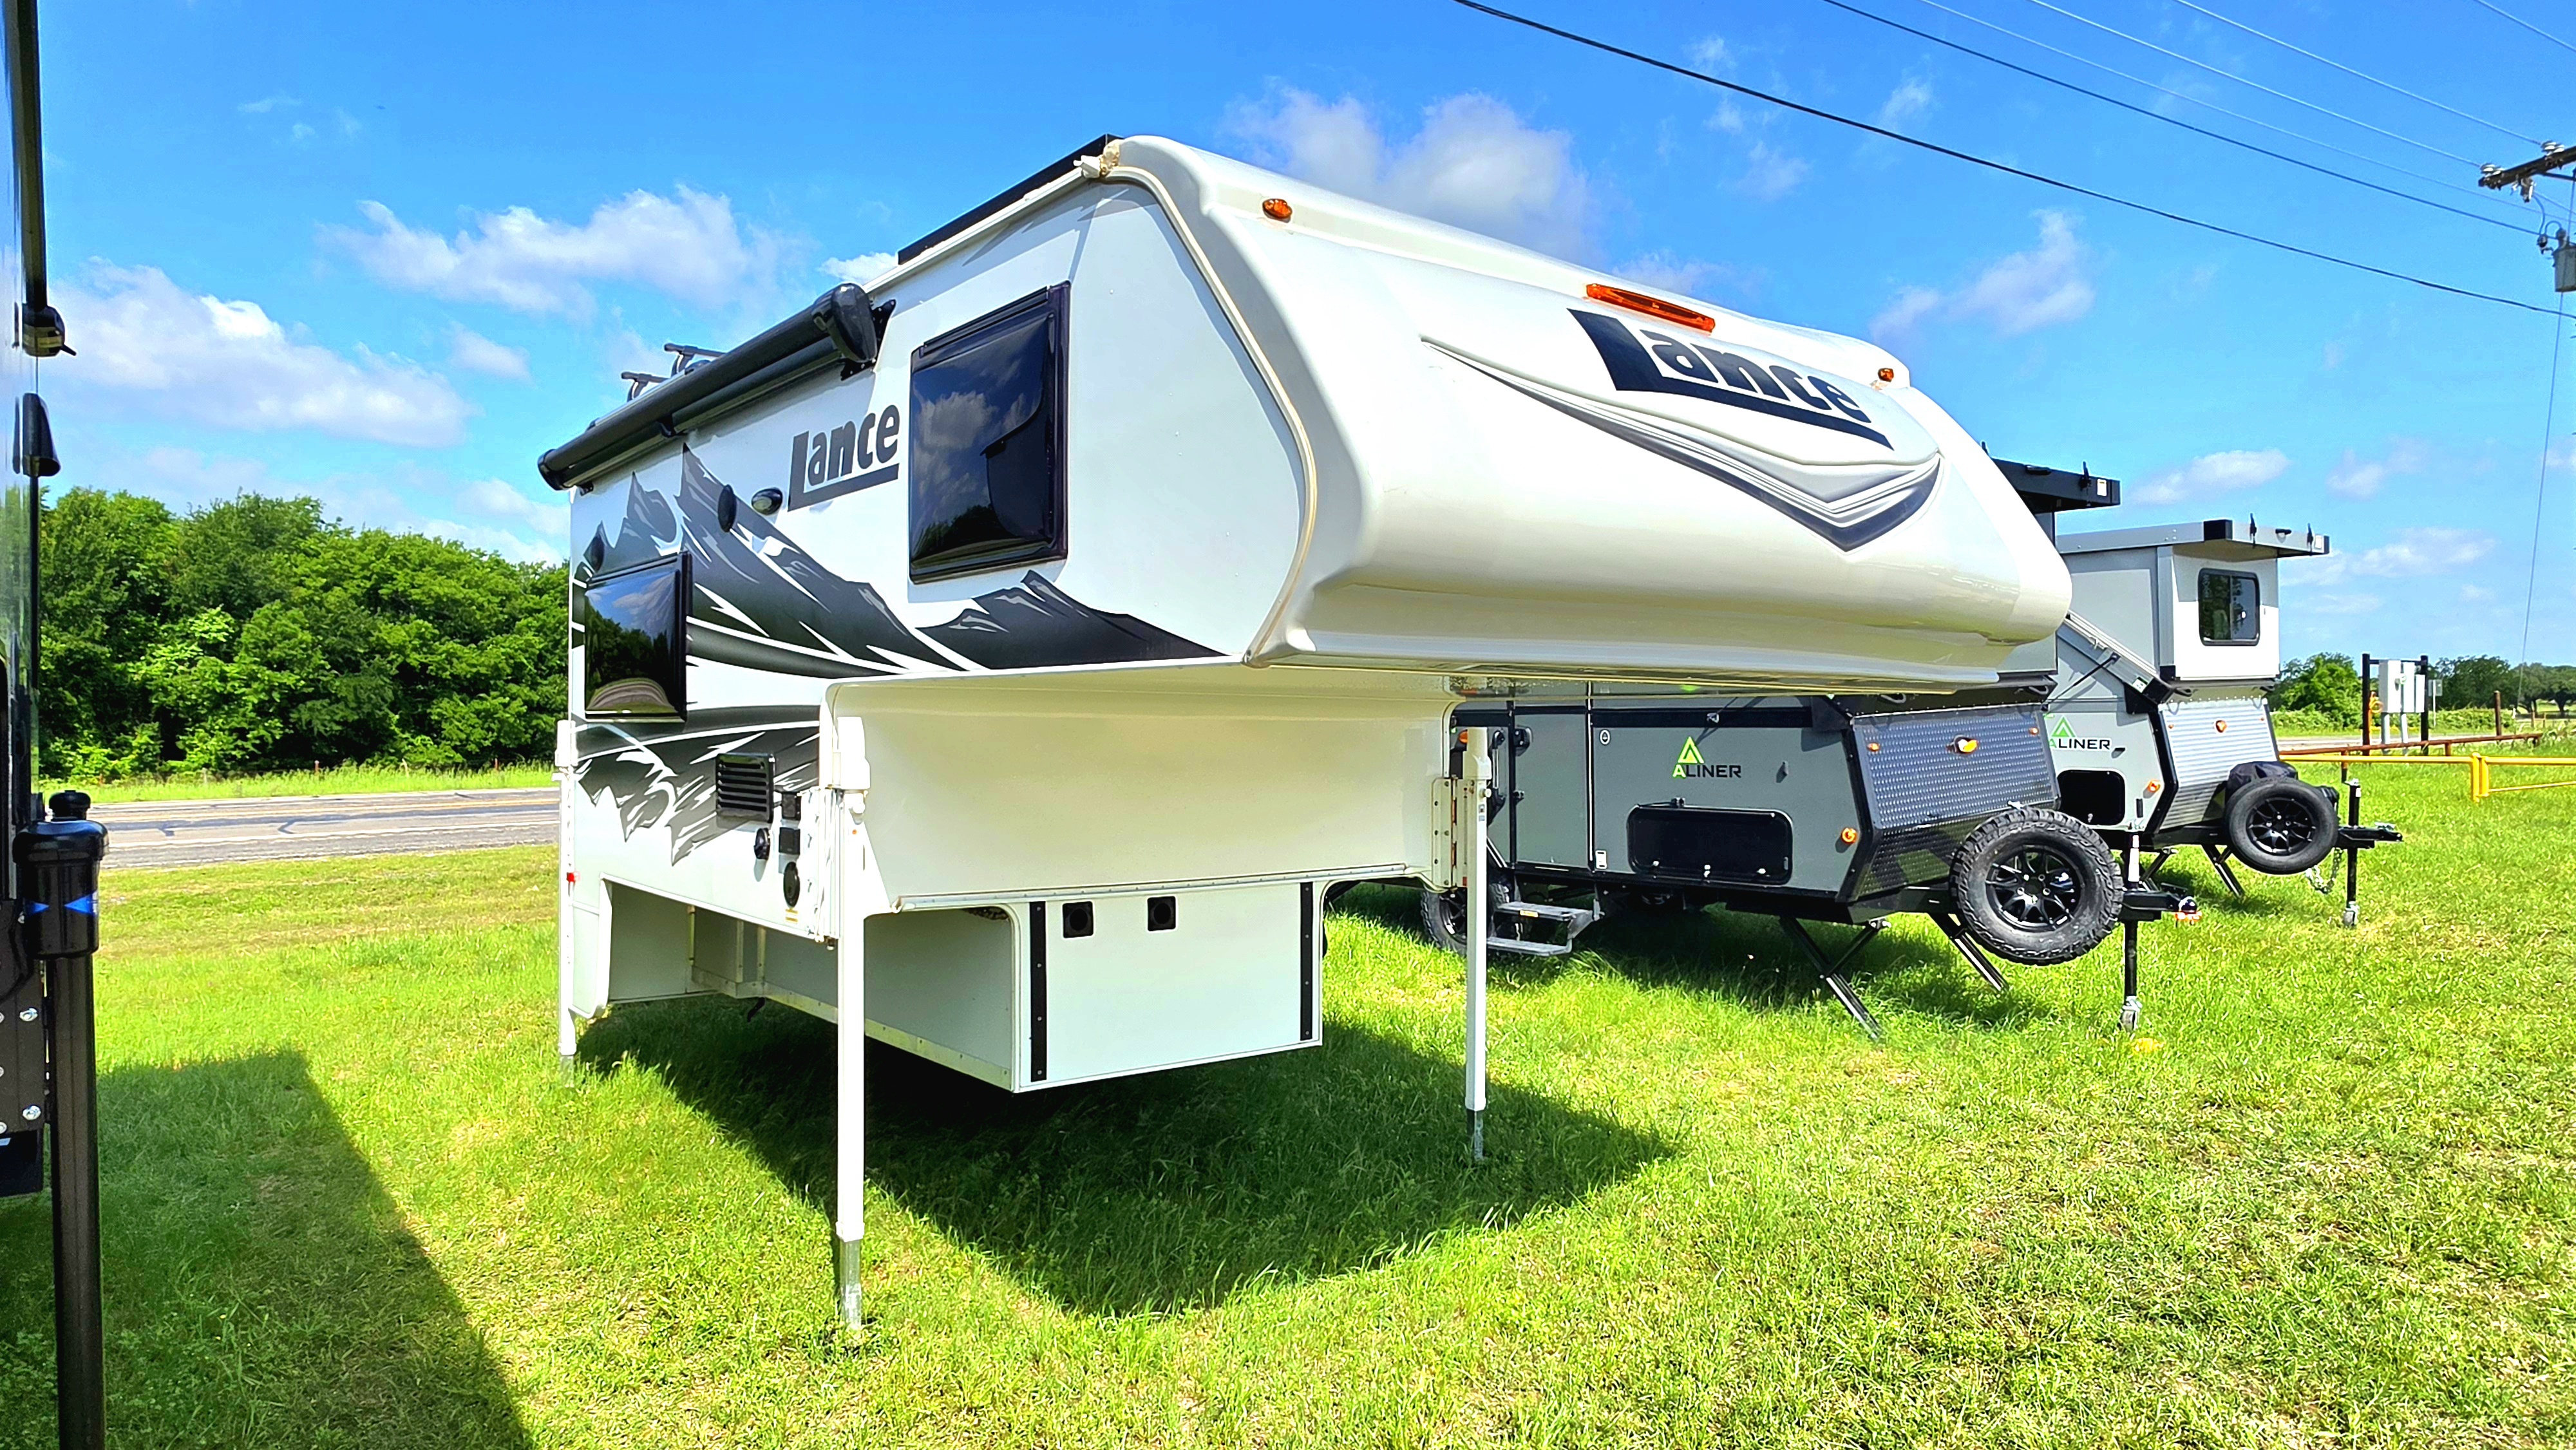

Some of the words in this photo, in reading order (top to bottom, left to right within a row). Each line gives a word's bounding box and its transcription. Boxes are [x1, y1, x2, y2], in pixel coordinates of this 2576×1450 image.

[1567, 308, 1895, 451] Lance
[788, 404, 900, 512] Lance
[1672, 764, 1741, 778] ALINER
